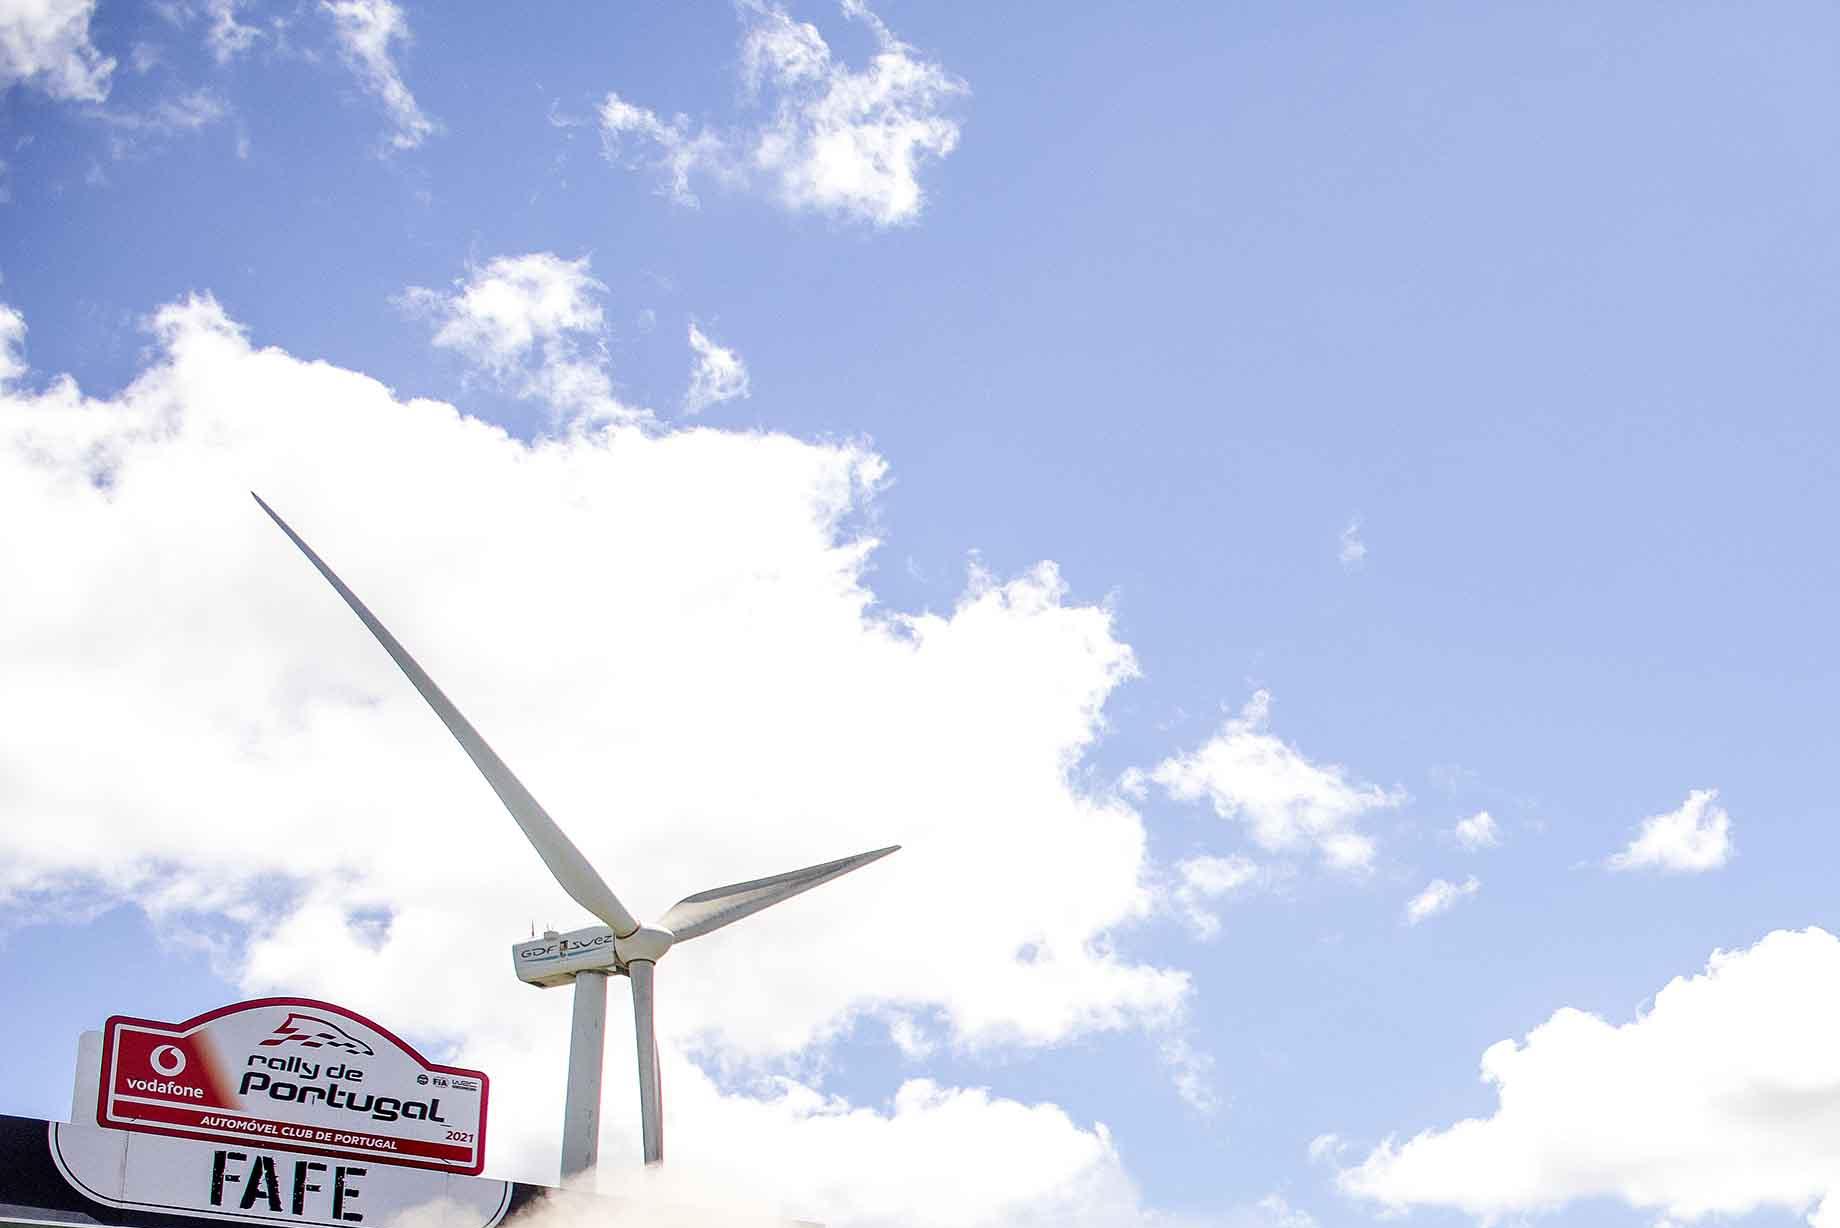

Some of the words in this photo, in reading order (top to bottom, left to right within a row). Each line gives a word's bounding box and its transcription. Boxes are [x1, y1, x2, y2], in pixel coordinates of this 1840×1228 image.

[248, 1054, 320, 1080] rally
[326, 1064, 364, 1083] de
[127, 1077, 204, 1099] vodafone
[239, 1071, 445, 1122] Portugal
[200, 1115, 279, 1136] AUTOMÓVEL
[282, 1126, 313, 1140] CLUB
[315, 1131, 332, 1143] DE
[334, 1134, 398, 1151] PORTUGAL
[445, 1131, 474, 1144] 2021
[210, 1149, 368, 1223] FAFE
